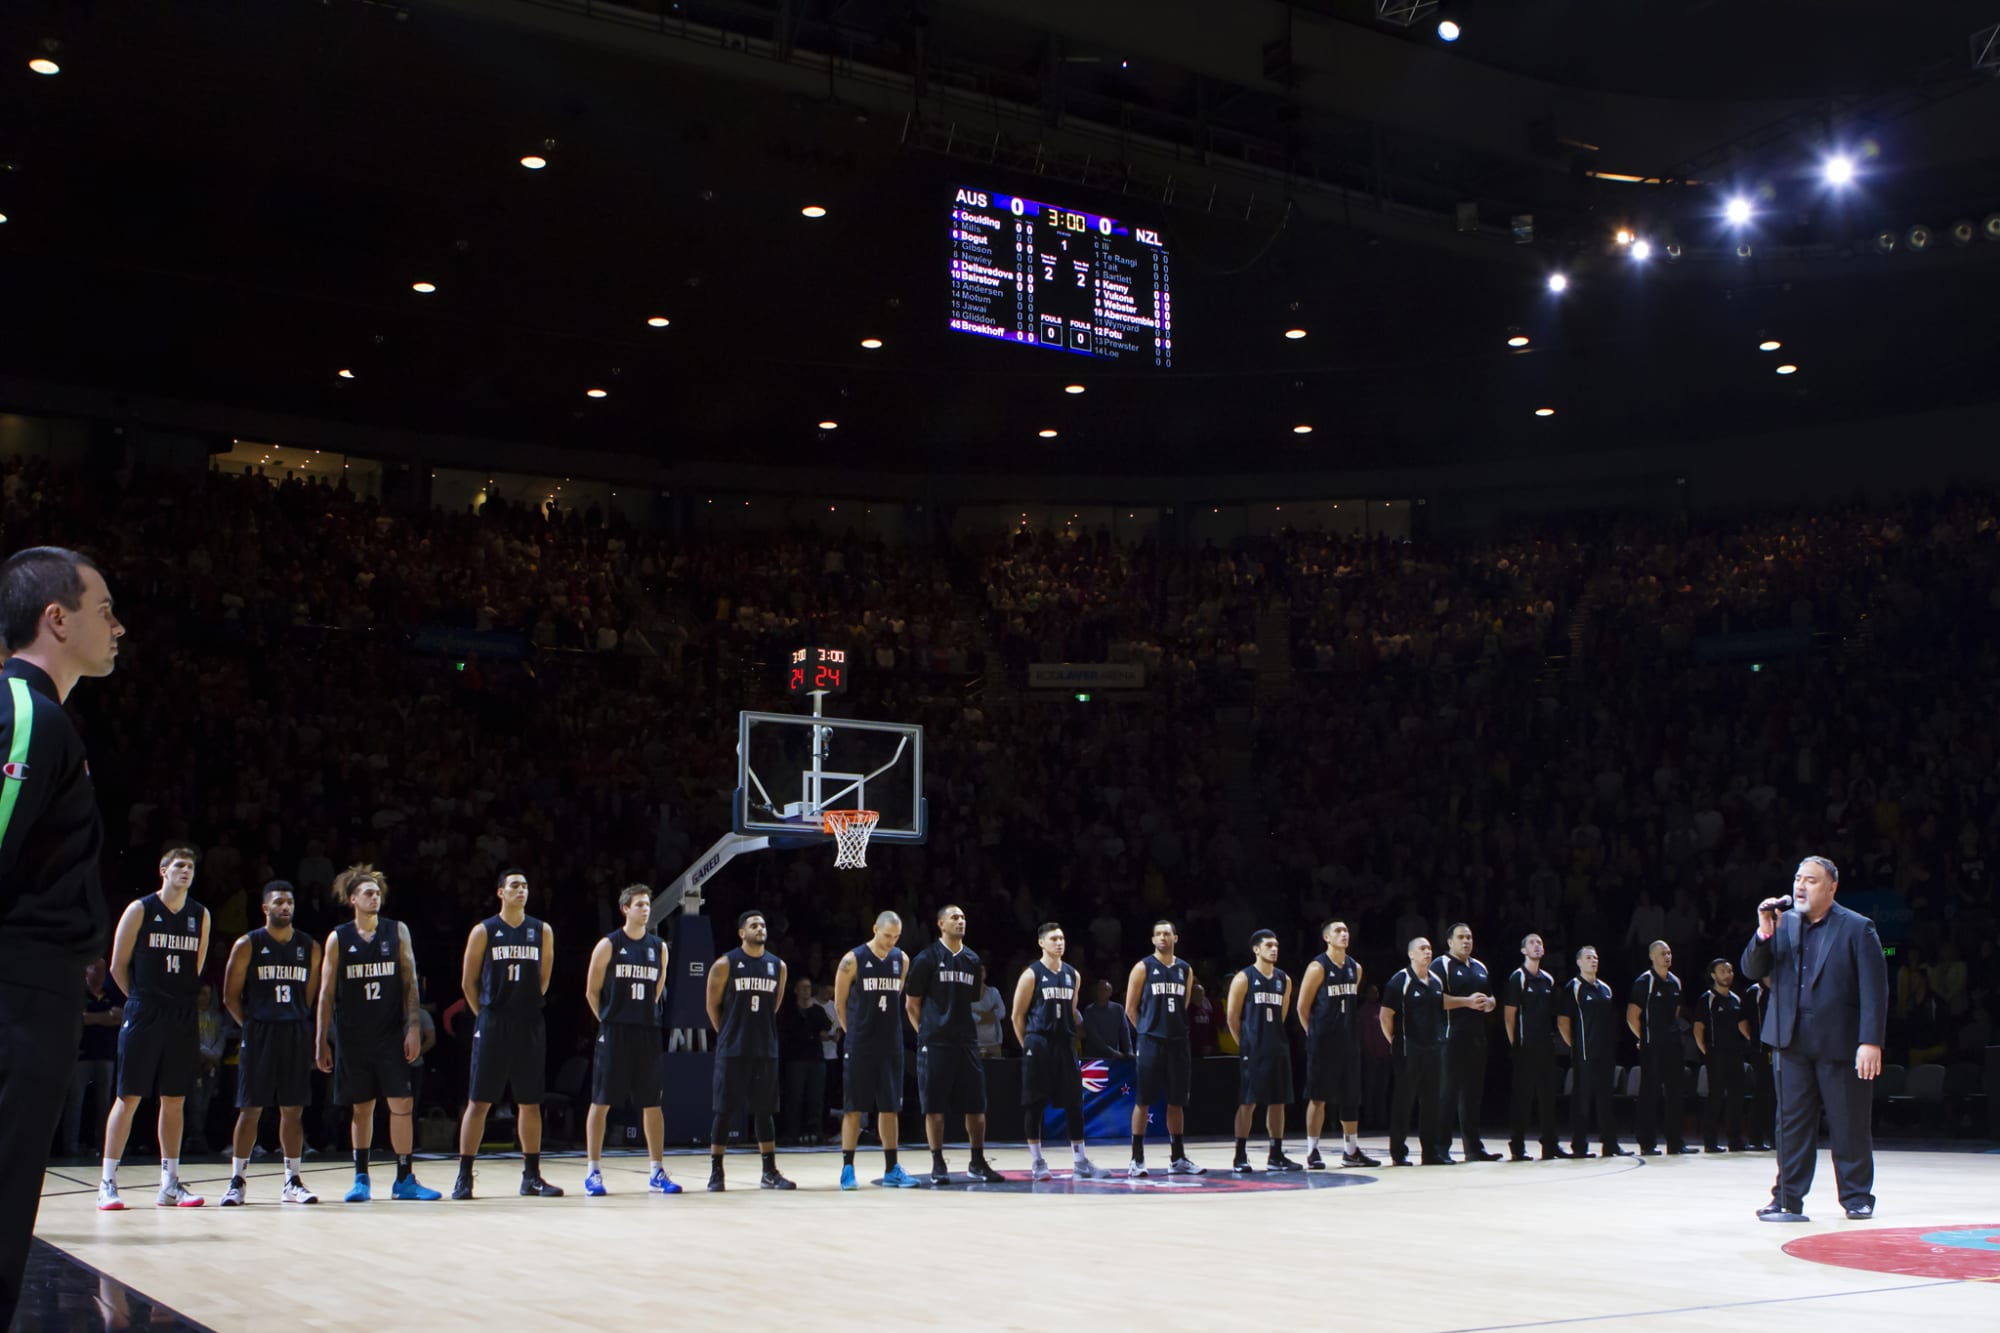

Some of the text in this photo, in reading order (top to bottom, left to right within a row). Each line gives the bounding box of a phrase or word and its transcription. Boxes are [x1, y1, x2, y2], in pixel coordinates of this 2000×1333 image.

[956, 189, 988, 207] AUS
[1011, 197, 1024, 216] 0
[952, 211, 1033, 234] 4 Goulding 0 0
[1048, 208, 1086, 232] 3:00
[1099, 218, 1112, 235] 0
[961, 230, 988, 244] Bogut
[1016, 242, 1022, 252] 0
[1027, 244, 1033, 254] 0
[1061, 240, 1067, 250] 1
[1136, 228, 1162, 246] NZL
[962, 242, 992, 254] Gibson
[1016, 254, 1022, 262] 0
[1027, 256, 1033, 264] 0
[1163, 256, 1168, 264] 0
[962, 251, 992, 266] Newley
[1016, 263, 1022, 271] 0
[1027, 265, 1033, 273] 0
[1114, 254, 1137, 268] Rangi
[1163, 265, 1169, 273] 0
[961, 261, 1014, 280] Dellavedova
[1016, 272, 1022, 282] 0
[1028, 274, 1034, 284] 0
[1044, 266, 1053, 280] 2
[1077, 273, 1085, 287] 2
[1103, 271, 1132, 284] Bartlett
[1154, 272, 1159, 280] 0
[1164, 274, 1169, 282] 0
[951, 270, 1034, 294] 10 Bairstow 0 0
[962, 280, 1004, 297] Andersen
[1017, 292, 1023, 300] 0
[1028, 294, 1034, 302] 0
[962, 290, 991, 304] Motum
[1103, 280, 1128, 294] Kenny
[1154, 291, 1159, 300] 0
[1164, 292, 1170, 302] 0
[1104, 290, 1134, 304] Vukona
[1154, 300, 1160, 309] 0
[1164, 302, 1170, 311] 0
[962, 302, 987, 312] Jawai
[1017, 312, 1023, 320] 0
[1104, 299, 1138, 314] Webster
[1154, 310, 1160, 318] 0
[1165, 312, 1170, 320] 0
[962, 312, 996, 324] Gliddon
[1017, 322, 1023, 330] 0
[1028, 324, 1034, 332] 0
[1040, 314, 1062, 324] FOULS
[1070, 320, 1091, 330] FOULS
[1104, 310, 1154, 326] Abercrombie
[1155, 320, 1160, 328] 0
[1165, 321, 1170, 330] 0
[1048, 328, 1054, 338] 0
[1104, 319, 1140, 332] Wynyard
[1155, 329, 1160, 337] 0
[1017, 332, 1023, 340] 0
[1028, 333, 1034, 342] 0
[1078, 334, 1084, 344] 0
[1094, 327, 1171, 349] 12 Fotu 0 0
[1155, 348, 1161, 356] 0
[1166, 350, 1171, 358] 0
[1156, 358, 1161, 366] 0
[1166, 360, 1171, 368] 0
[818, 649, 844, 663] 3:00
[790, 668, 804, 690] 24
[815, 666, 840, 687] 24
[692, 853, 720, 885] GARED
[149, 932, 199, 951] NEW ZEALAND
[492, 946, 538, 960] NEW ZEALAND
[166, 954, 180, 973] 14
[346, 964, 364, 979] NEW
[258, 965, 306, 982] NEW ZEALAND
[508, 964, 520, 981] 11
[616, 964, 658, 982] NEW ZEALAND
[364, 982, 381, 1000] 12
[631, 983, 645, 1000] 10
[735, 977, 750, 991] NEW
[863, 978, 878, 991] NEW
[1151, 982, 1185, 996] NEW ZEALAND
[1328, 984, 1340, 996] NEW
[275, 985, 291, 1003] 13
[1042, 987, 1074, 1000] NEW ZEALAND
[1254, 992, 1283, 1006] NEW ZEALAND
[751, 995, 760, 1012] 9
[878, 995, 887, 1012] 4
[1168, 998, 1175, 1013] 5
